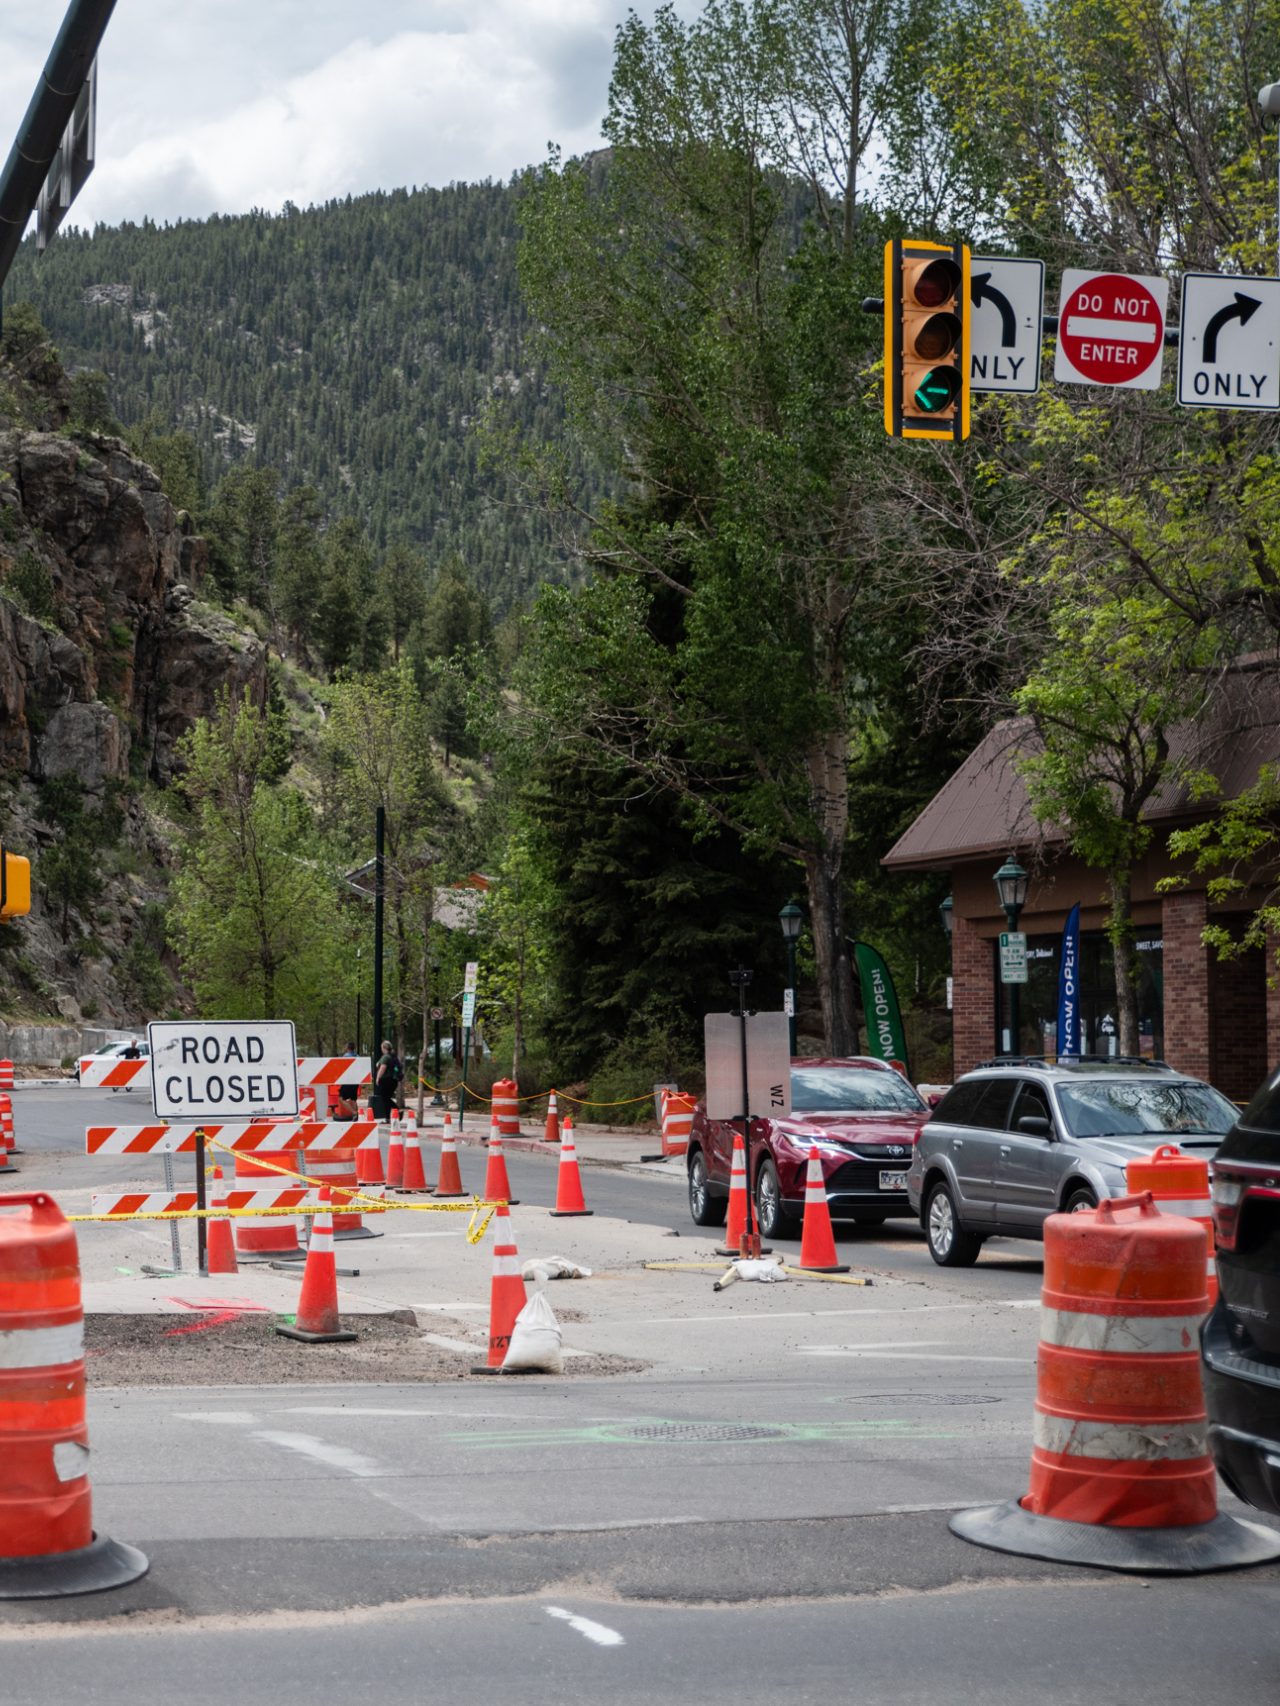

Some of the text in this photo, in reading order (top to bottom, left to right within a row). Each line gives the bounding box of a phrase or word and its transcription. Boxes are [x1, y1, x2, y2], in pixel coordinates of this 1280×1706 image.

[1078, 293, 1150, 317] DO NOT
[971, 355, 1025, 380] NLY
[1080, 344, 1138, 365] ENTER
[1194, 371, 1268, 398] ONLY
[871, 968, 896, 1057] NOW OPEN!
[1064, 1000, 1073, 1048] NOW
[181, 1036, 264, 1064] ROAD
[165, 1075, 285, 1103] CLOSED
[770, 1084, 785, 1107] WZ
